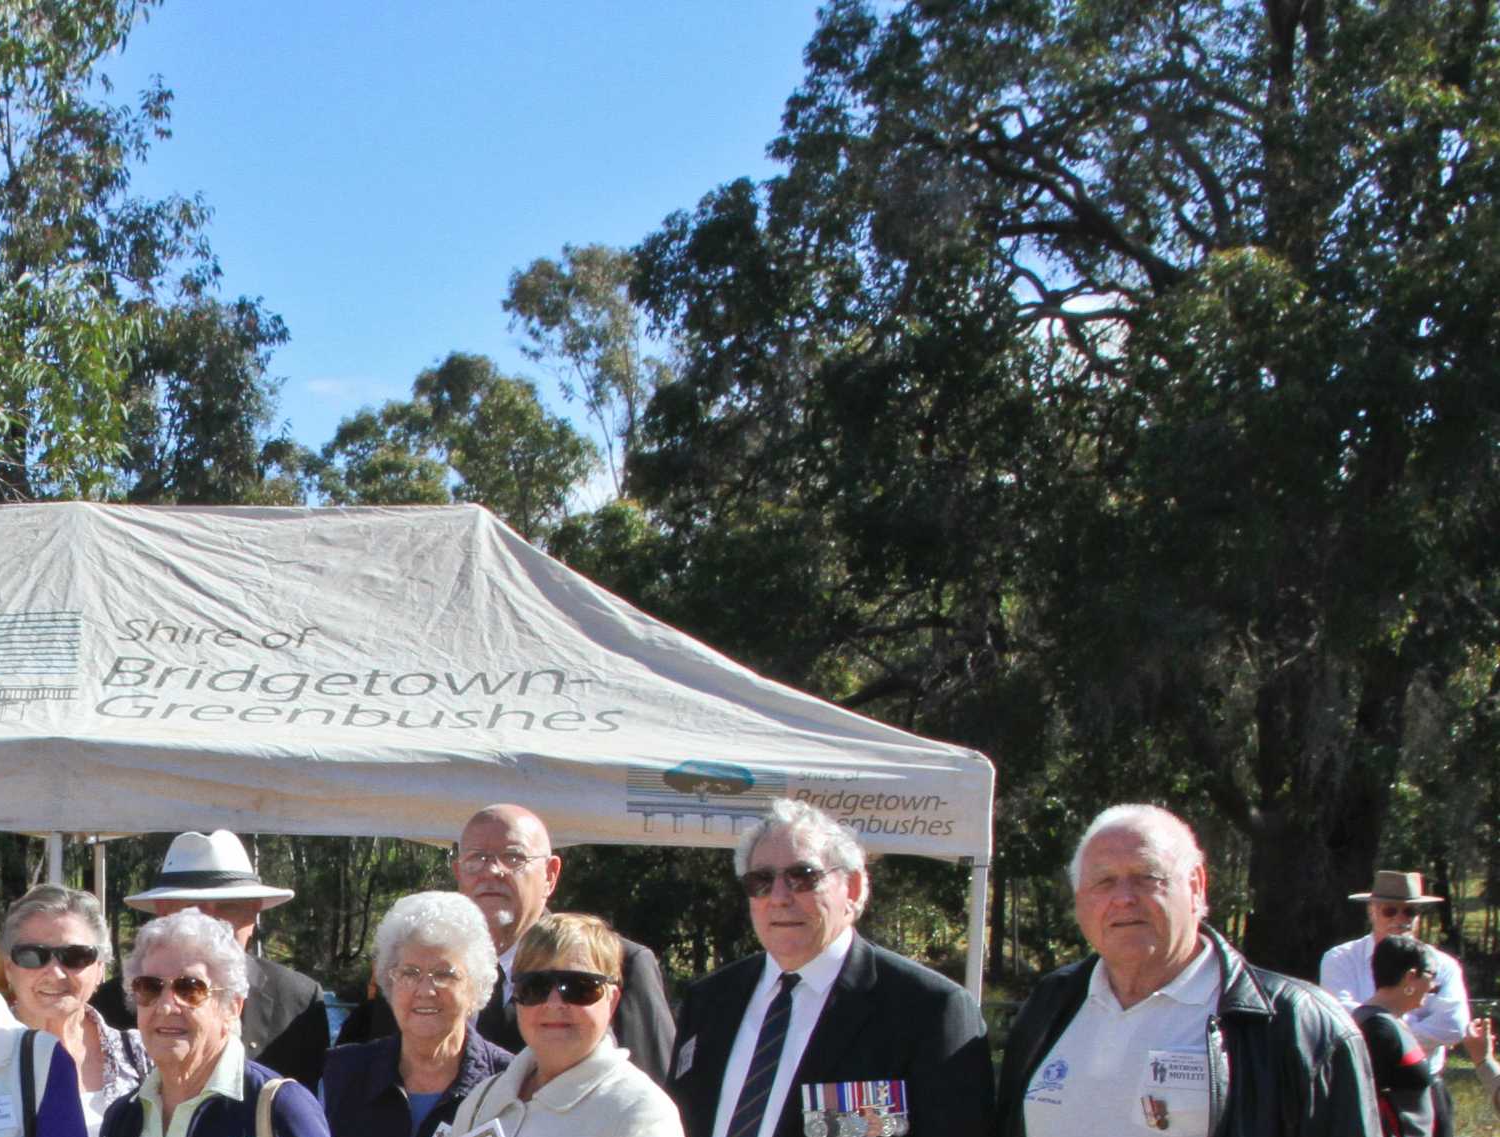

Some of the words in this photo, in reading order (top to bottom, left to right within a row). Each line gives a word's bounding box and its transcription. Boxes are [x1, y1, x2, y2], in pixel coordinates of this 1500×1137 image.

[117, 618, 243, 649] Shire
[261, 626, 319, 650] of
[101, 655, 594, 703] Bridgetown-
[94, 694, 624, 733] Greenbushes
